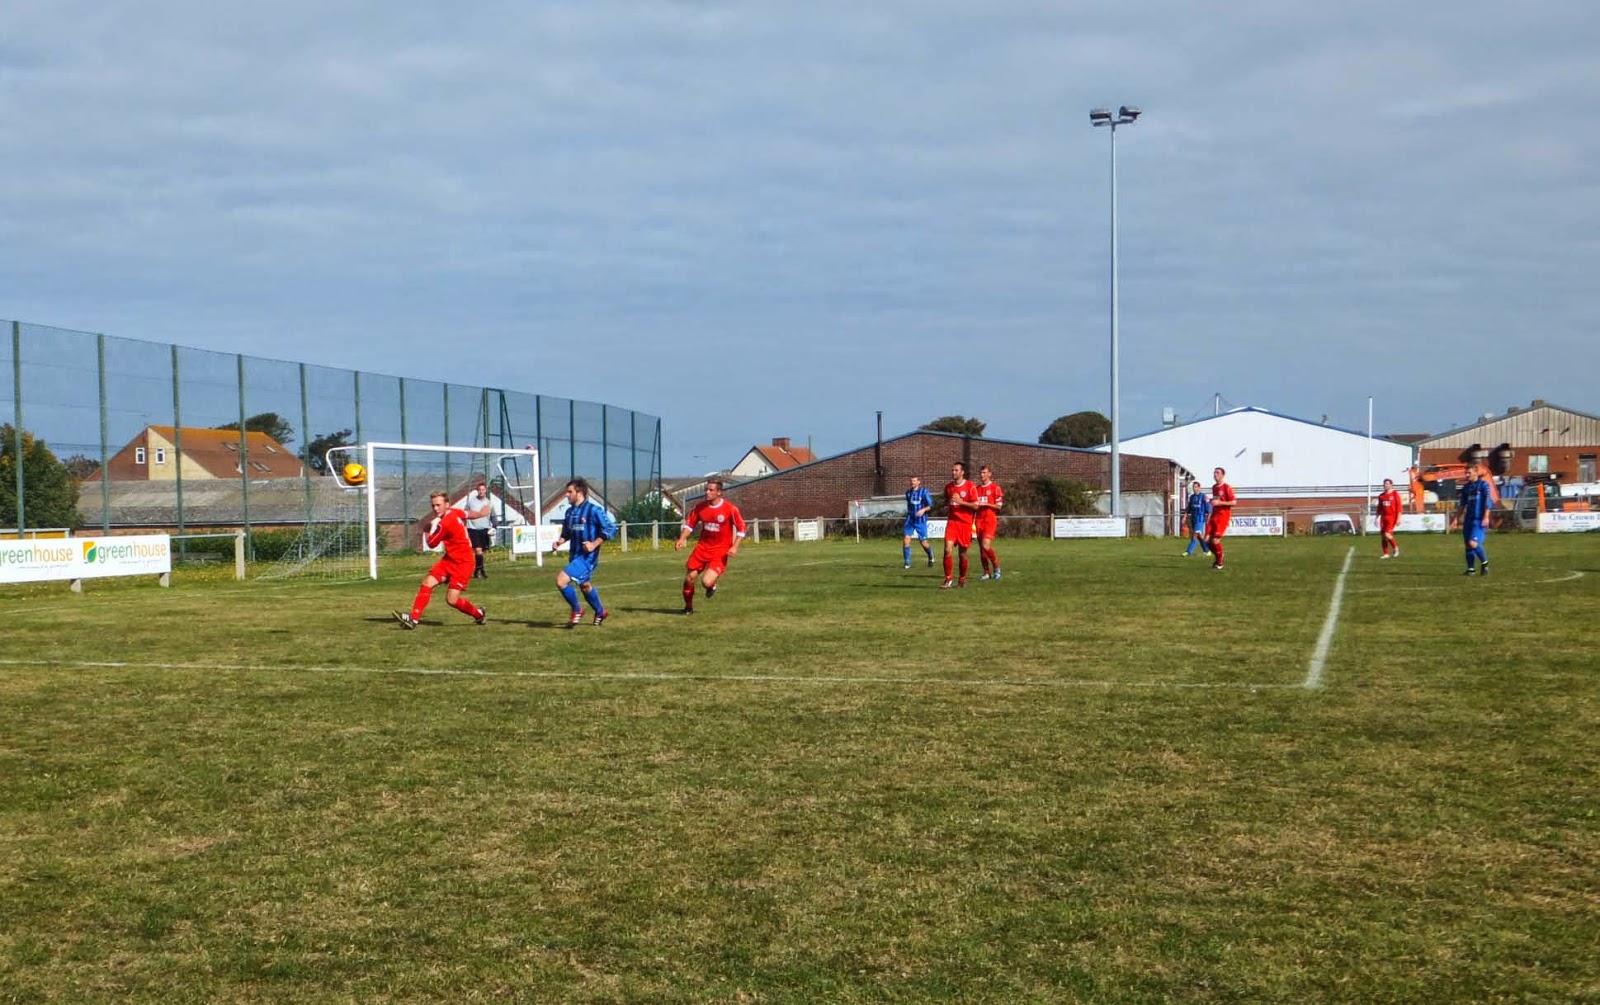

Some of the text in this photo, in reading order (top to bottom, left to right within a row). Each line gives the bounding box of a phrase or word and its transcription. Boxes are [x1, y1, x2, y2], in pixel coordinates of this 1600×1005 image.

[1227, 517, 1277, 527] YNESIDE CLUB
[1552, 513, 1567, 521] The
[1569, 513, 1595, 521] Crown
[98, 540, 167, 563] greenhouse
